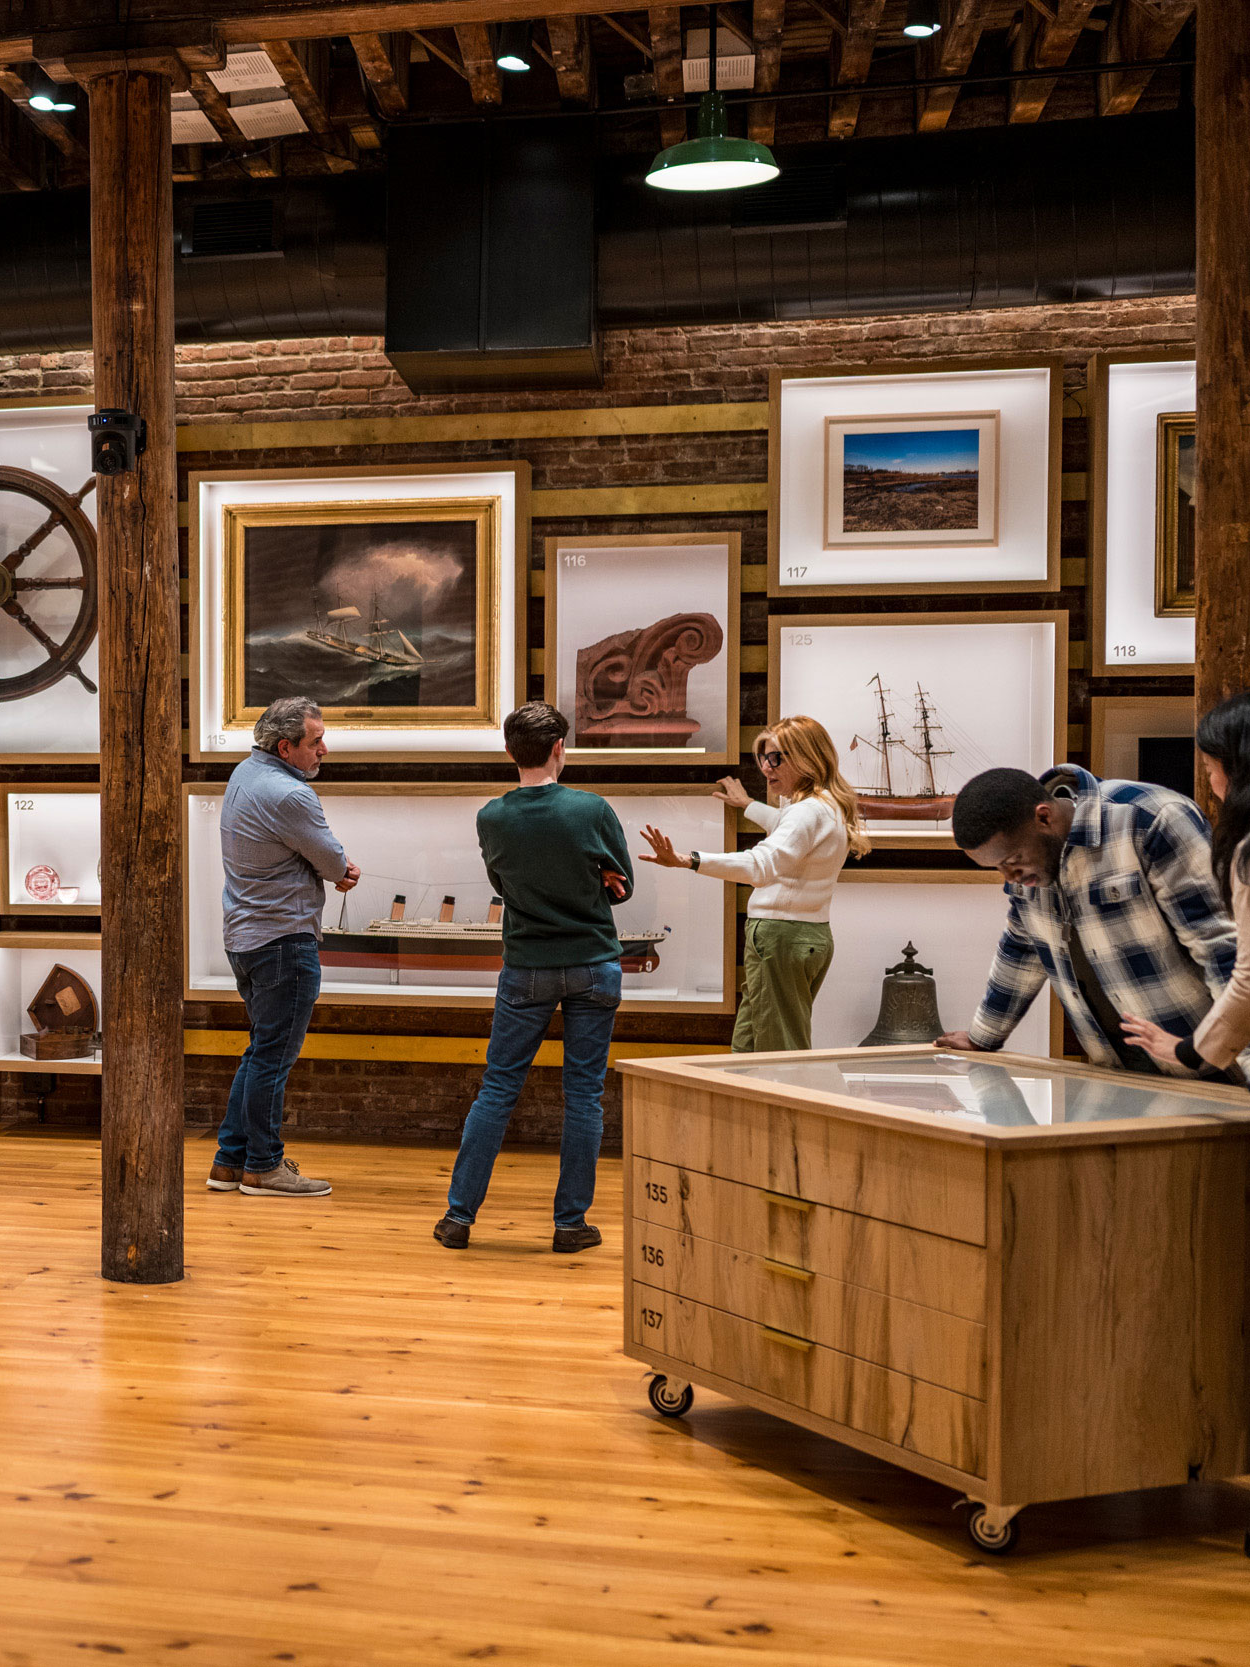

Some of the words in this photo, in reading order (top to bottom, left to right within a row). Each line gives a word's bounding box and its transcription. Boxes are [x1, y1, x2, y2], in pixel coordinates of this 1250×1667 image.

[564, 555, 586, 567] 116
[786, 566, 808, 578] 117
[788, 634, 813, 646] 125
[1113, 645, 1137, 657] 118
[206, 734, 227, 745] 115
[14, 800, 34, 811] 122
[196, 801, 217, 813] 24
[645, 1182, 668, 1204] 135
[641, 1244, 665, 1267] 136
[641, 1307, 663, 1330] 137
